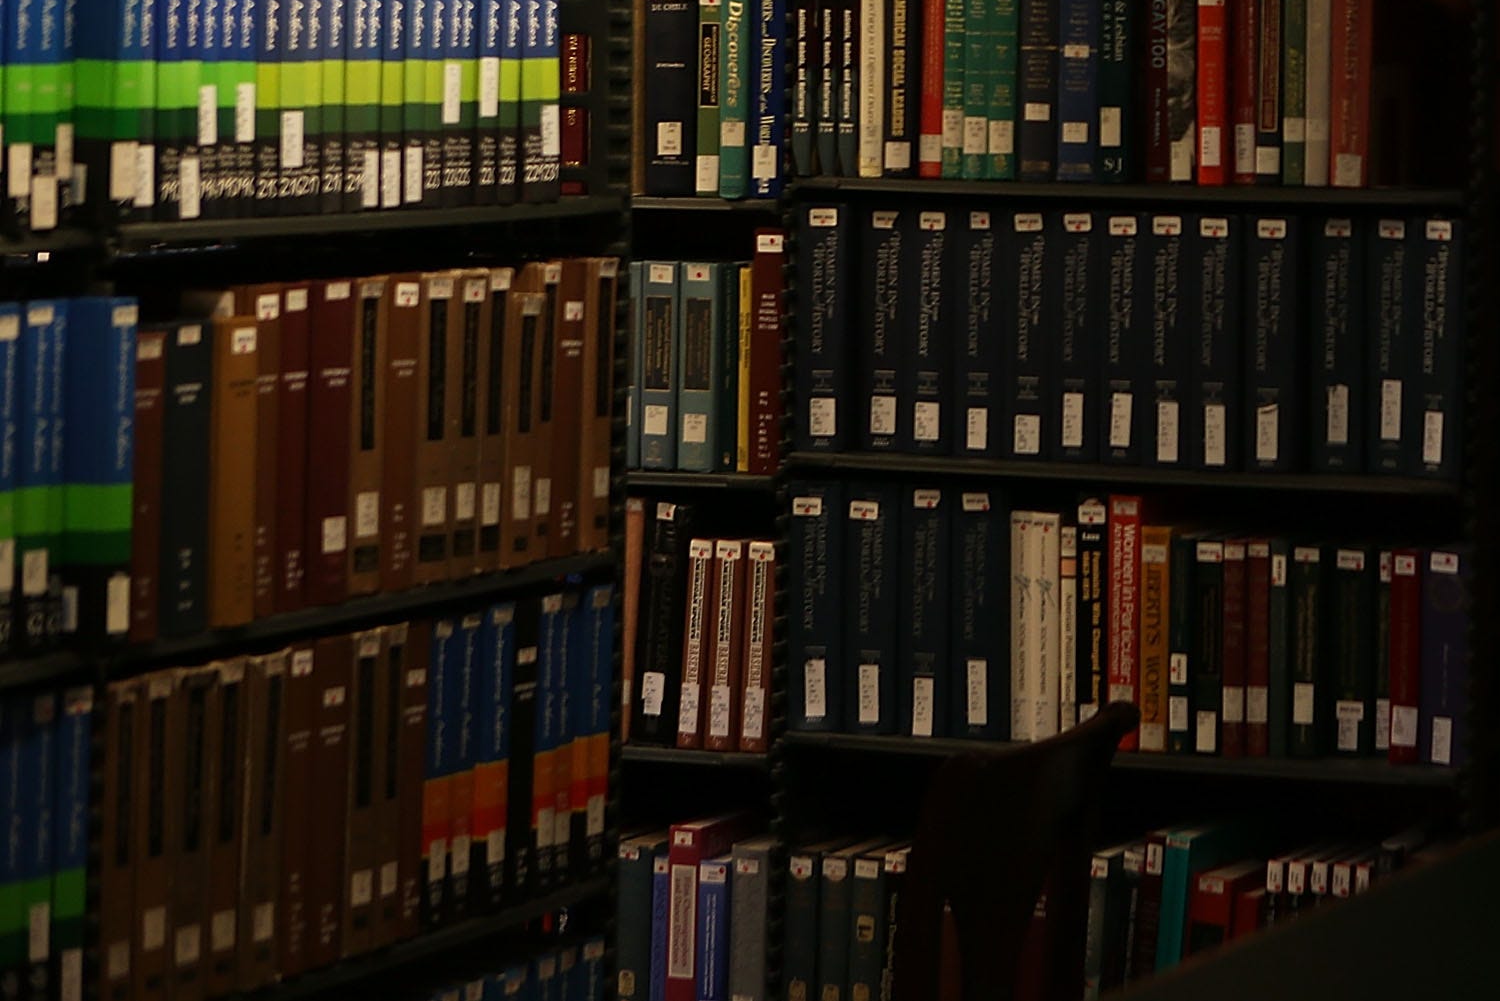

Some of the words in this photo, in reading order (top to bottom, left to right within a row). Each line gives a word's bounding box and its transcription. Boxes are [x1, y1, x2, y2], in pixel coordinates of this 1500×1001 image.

[1113, 0, 1127, 13] &
[725, 1, 744, 107] Discoverers
[1113, 15, 1127, 62] Lesbian
[1150, 37, 1166, 69] 100
[702, 36, 712, 91] GEOGRAPHY
[891, 48, 907, 87] SOCIAL
[890, 88, 906, 136] LEADERS
[1122, 522, 1136, 584] Women
[1122, 585, 1136, 600] in
[687, 644, 700, 683] BASEBAL
[717, 646, 728, 686] BASEBAL
[750, 647, 762, 687] BASEBAL
[1145, 655, 1161, 722] WOMEN
